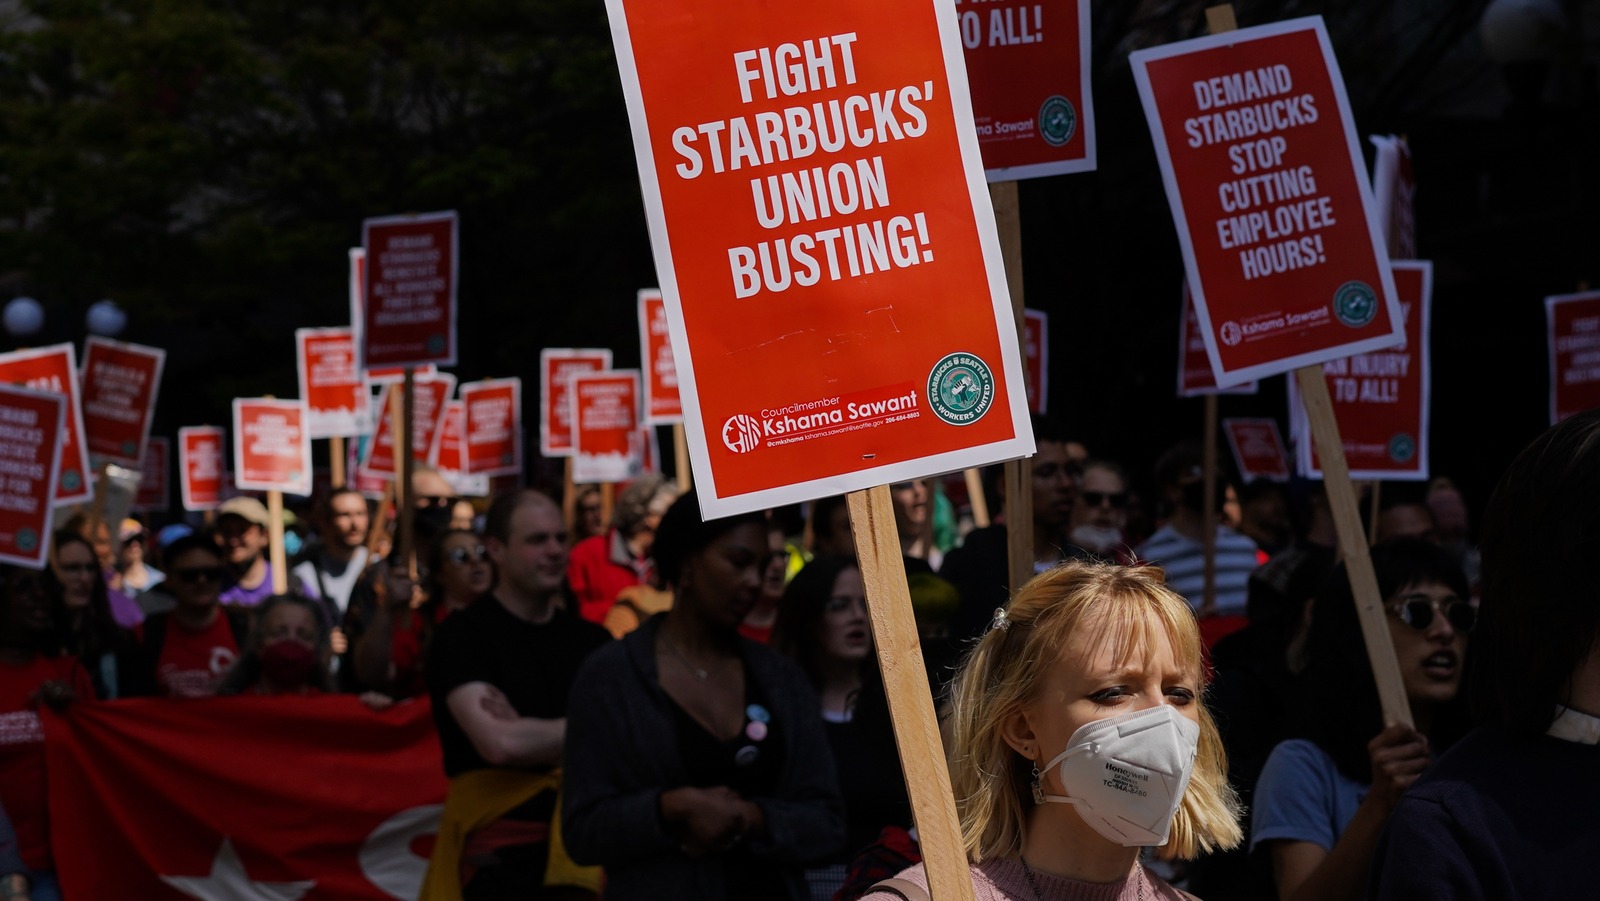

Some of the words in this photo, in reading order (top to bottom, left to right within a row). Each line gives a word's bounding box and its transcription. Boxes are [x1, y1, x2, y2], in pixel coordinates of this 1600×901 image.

[989, 5, 1042, 47] ALL!
[734, 32, 857, 104] FIGHT
[1192, 64, 1292, 111] DEMAND
[994, 118, 1034, 134] Sawant
[1184, 94, 1319, 148] STARBUCKS
[1227, 136, 1287, 175] STOP
[750, 156, 890, 229] UNION
[1218, 165, 1317, 213] CUTTING
[1215, 196, 1336, 249] EMPLOYEE
[728, 212, 934, 299] BUSTING!
[1239, 234, 1326, 281] HOURS!
[931, 360, 954, 403] STARBUCKS
[960, 357, 988, 380] SEATTLE
[1351, 353, 1410, 377] INJURY
[761, 396, 840, 419] Councilmember
[763, 409, 843, 437] Kshama
[847, 390, 917, 420] Sawant
[938, 405, 975, 421] WORKERS
[975, 384, 990, 413] UNITED
[1334, 378, 1357, 403] TO
[1360, 378, 1398, 403] ALL!
[766, 436, 804, 448] @cmkshama
[1105, 763, 1149, 782] Honeywell
